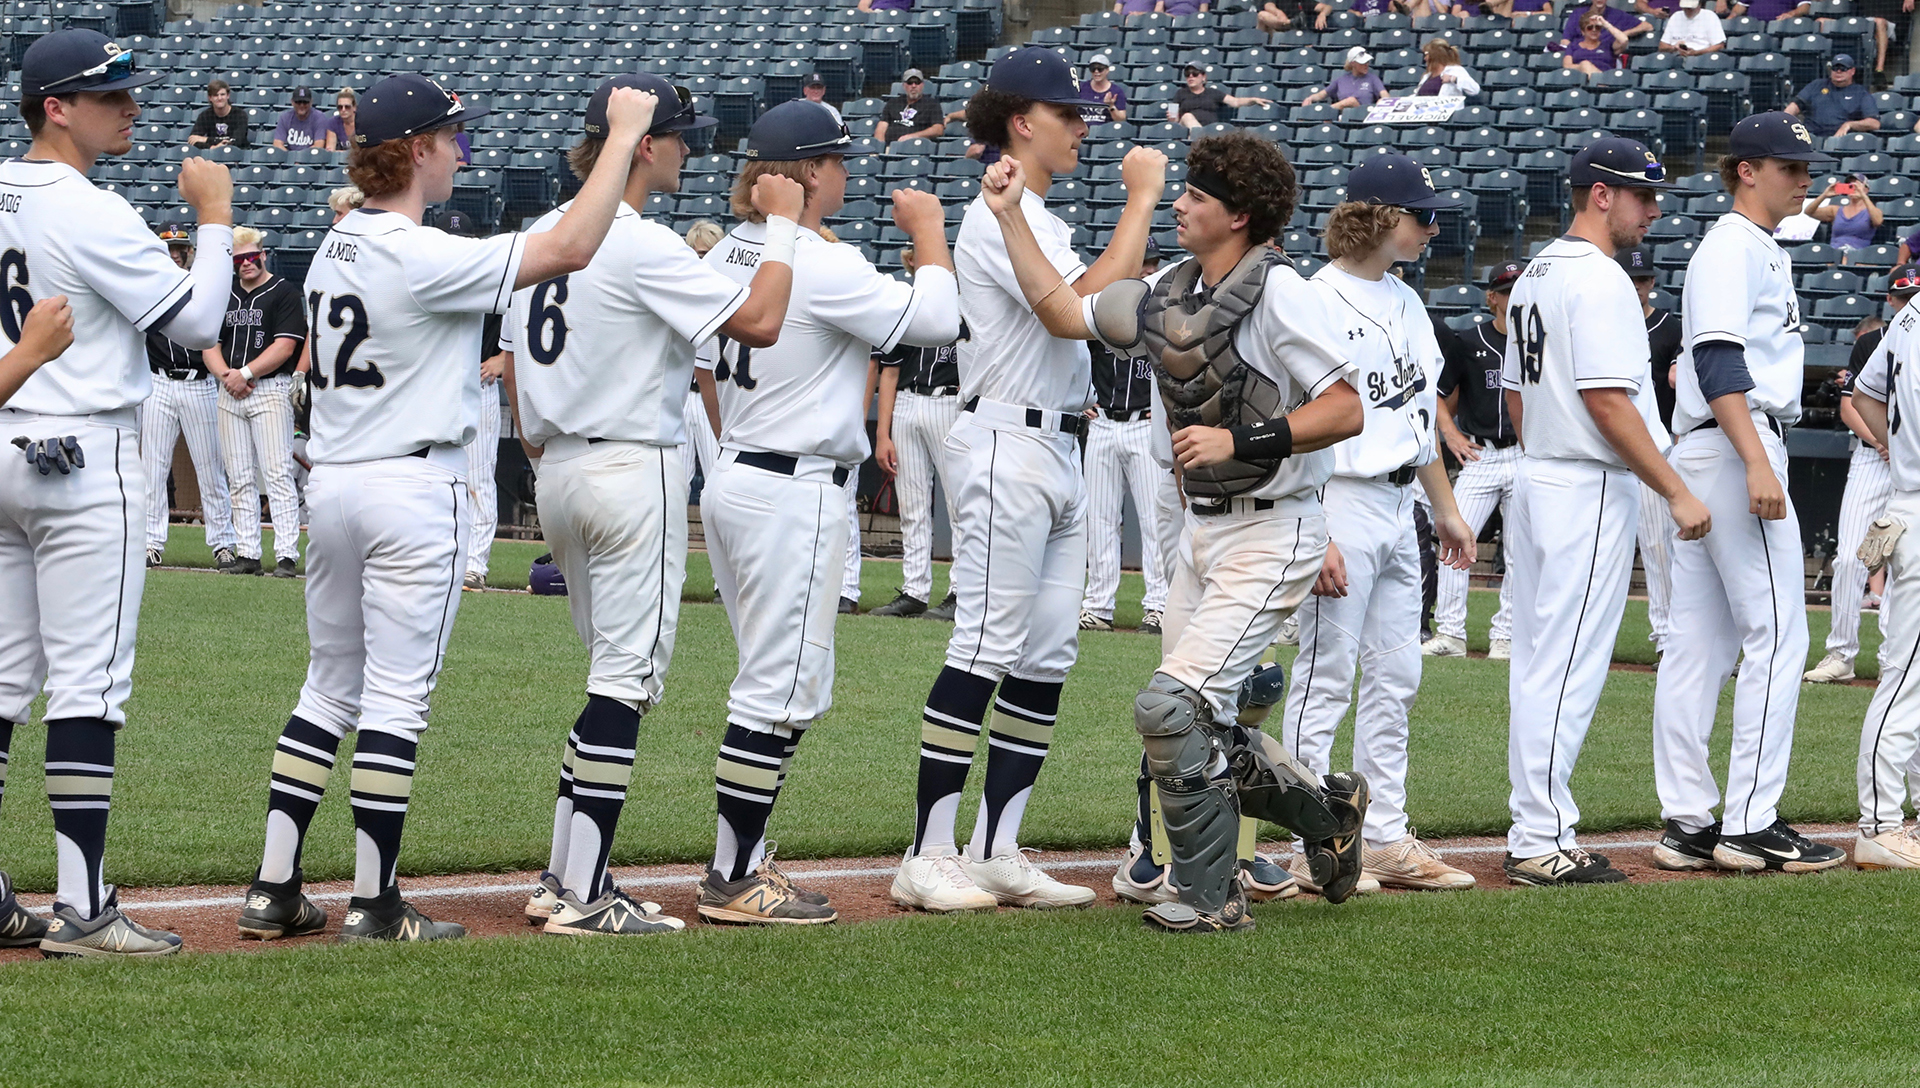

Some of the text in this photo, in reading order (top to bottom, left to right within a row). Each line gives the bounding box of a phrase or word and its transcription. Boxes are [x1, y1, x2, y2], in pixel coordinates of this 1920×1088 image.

[287, 128, 313, 145] Elder
[226, 308, 264, 327] ELDER
[524, 273, 573, 367] 6
[254, 331, 265, 349] 5
[308, 289, 386, 391] 12
[1510, 301, 1548, 387] 19
[938, 345, 958, 363] 26
[1135, 360, 1152, 380] 18
[1367, 371, 1388, 402] St
[597, 907, 629, 932] N
[100, 925, 130, 952] N
